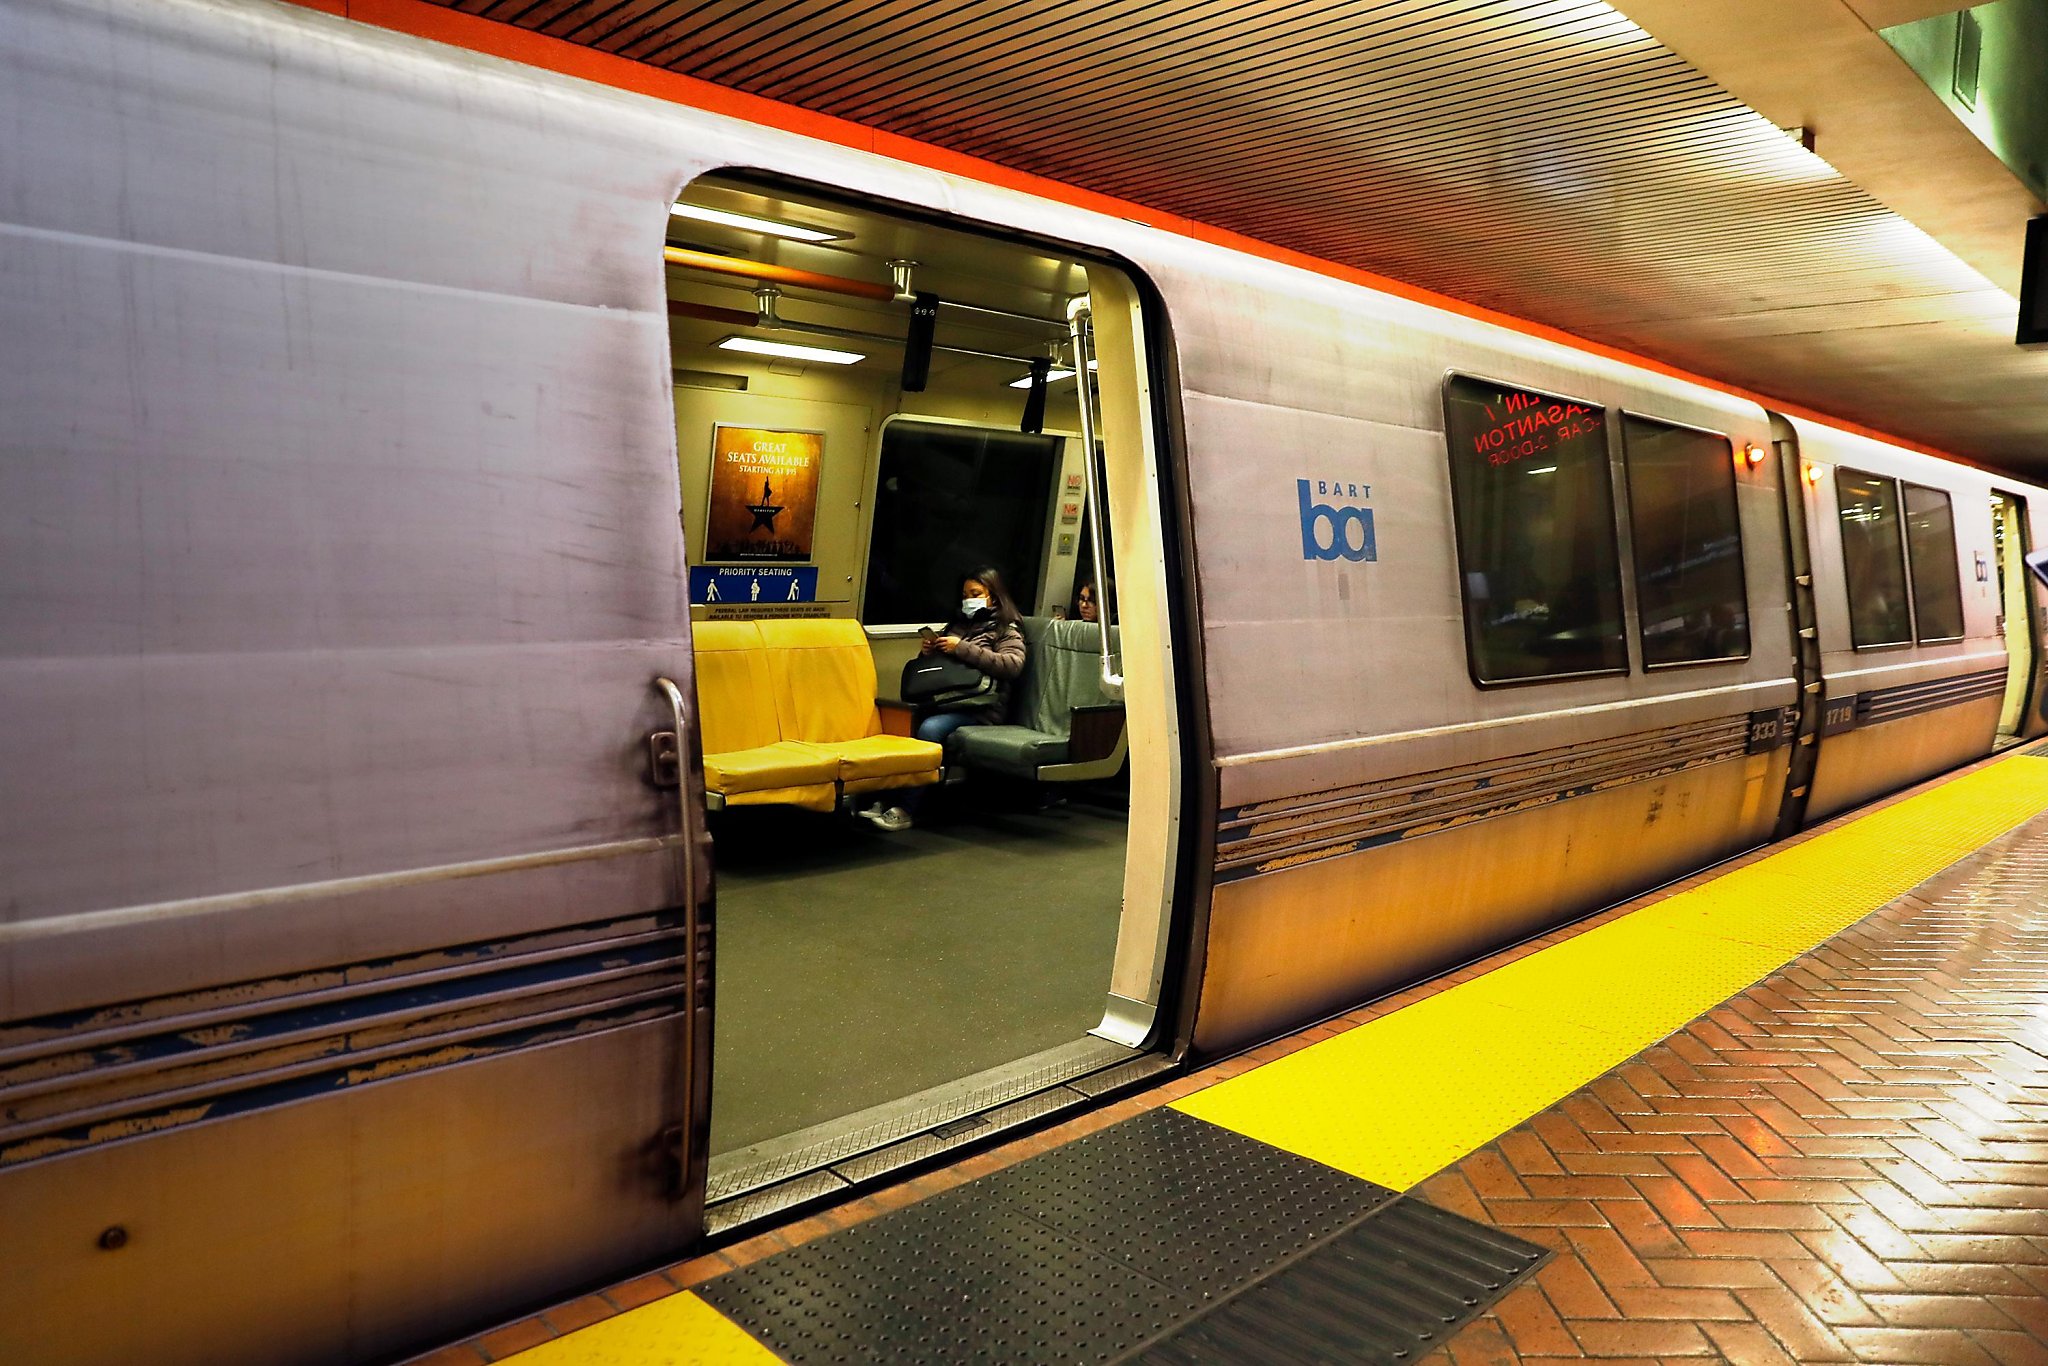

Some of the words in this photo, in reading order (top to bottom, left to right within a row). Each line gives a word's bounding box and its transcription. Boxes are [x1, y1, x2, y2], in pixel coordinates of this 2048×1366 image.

[753, 441, 787, 453] GREAT
[727, 451, 757, 464] SEATS
[758, 454, 810, 467] AVAILABLE
[739, 465, 774, 475] STARTING
[1318, 480, 1372, 499] BART
[719, 568, 757, 576] PRIORITY
[758, 568, 793, 576] SEATING
[1751, 721, 1777, 742] 333
